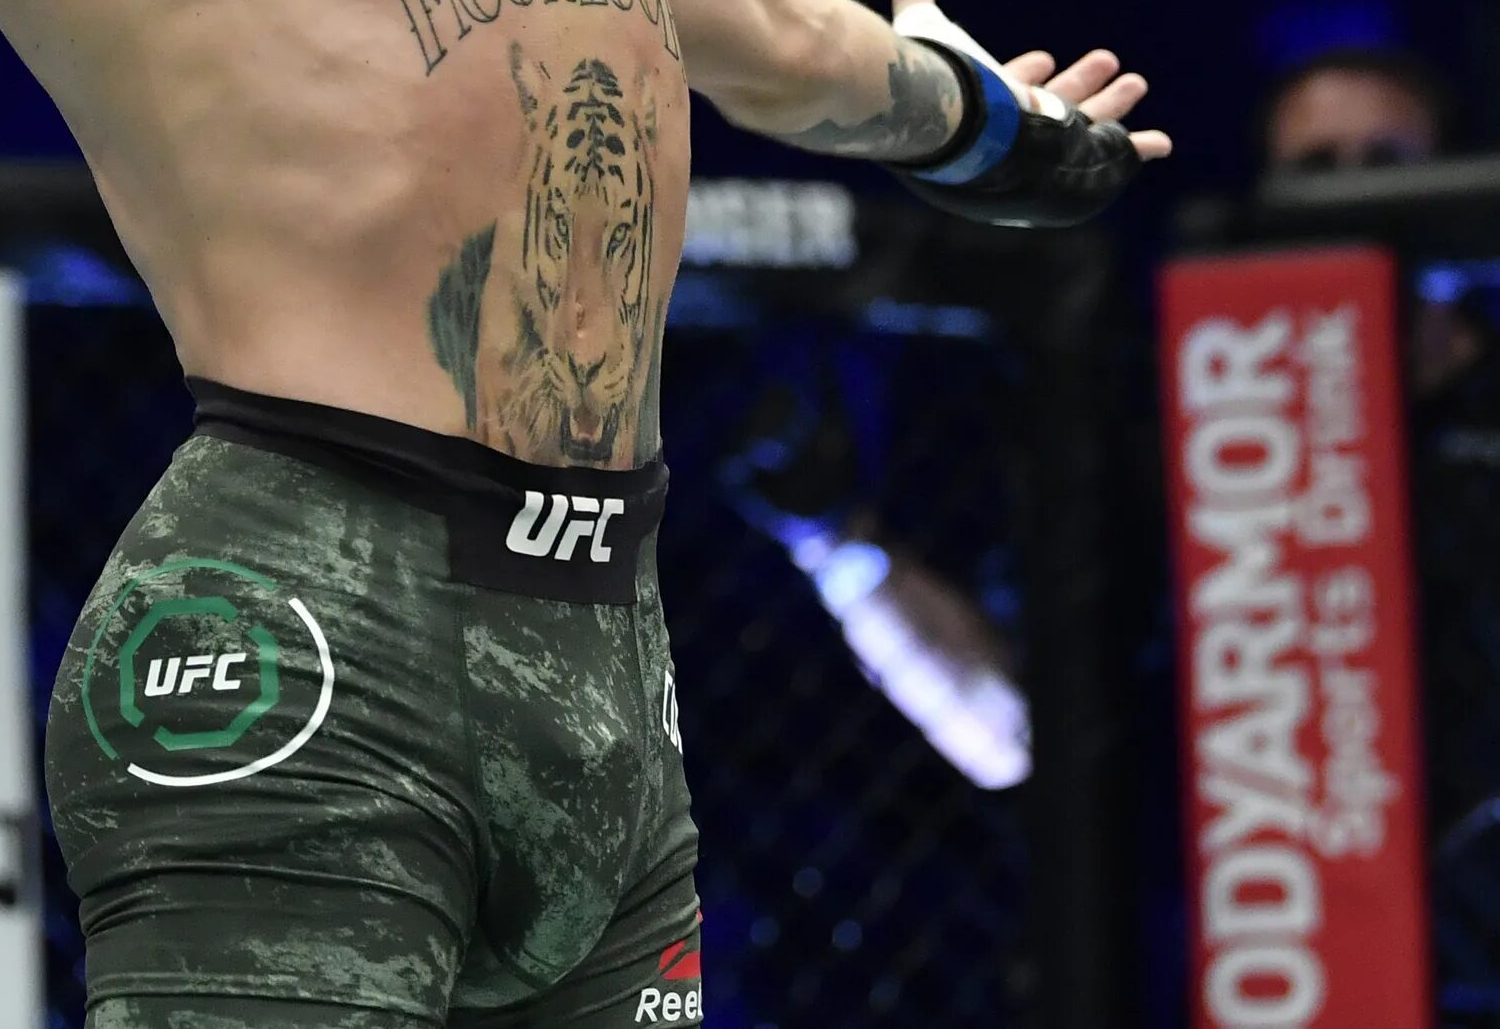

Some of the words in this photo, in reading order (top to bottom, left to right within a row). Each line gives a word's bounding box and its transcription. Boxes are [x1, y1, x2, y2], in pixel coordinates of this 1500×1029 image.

[505, 490, 625, 563] UFC
[143, 652, 248, 697] UFC
[1179, 316, 1325, 1029] ODYARMOR
